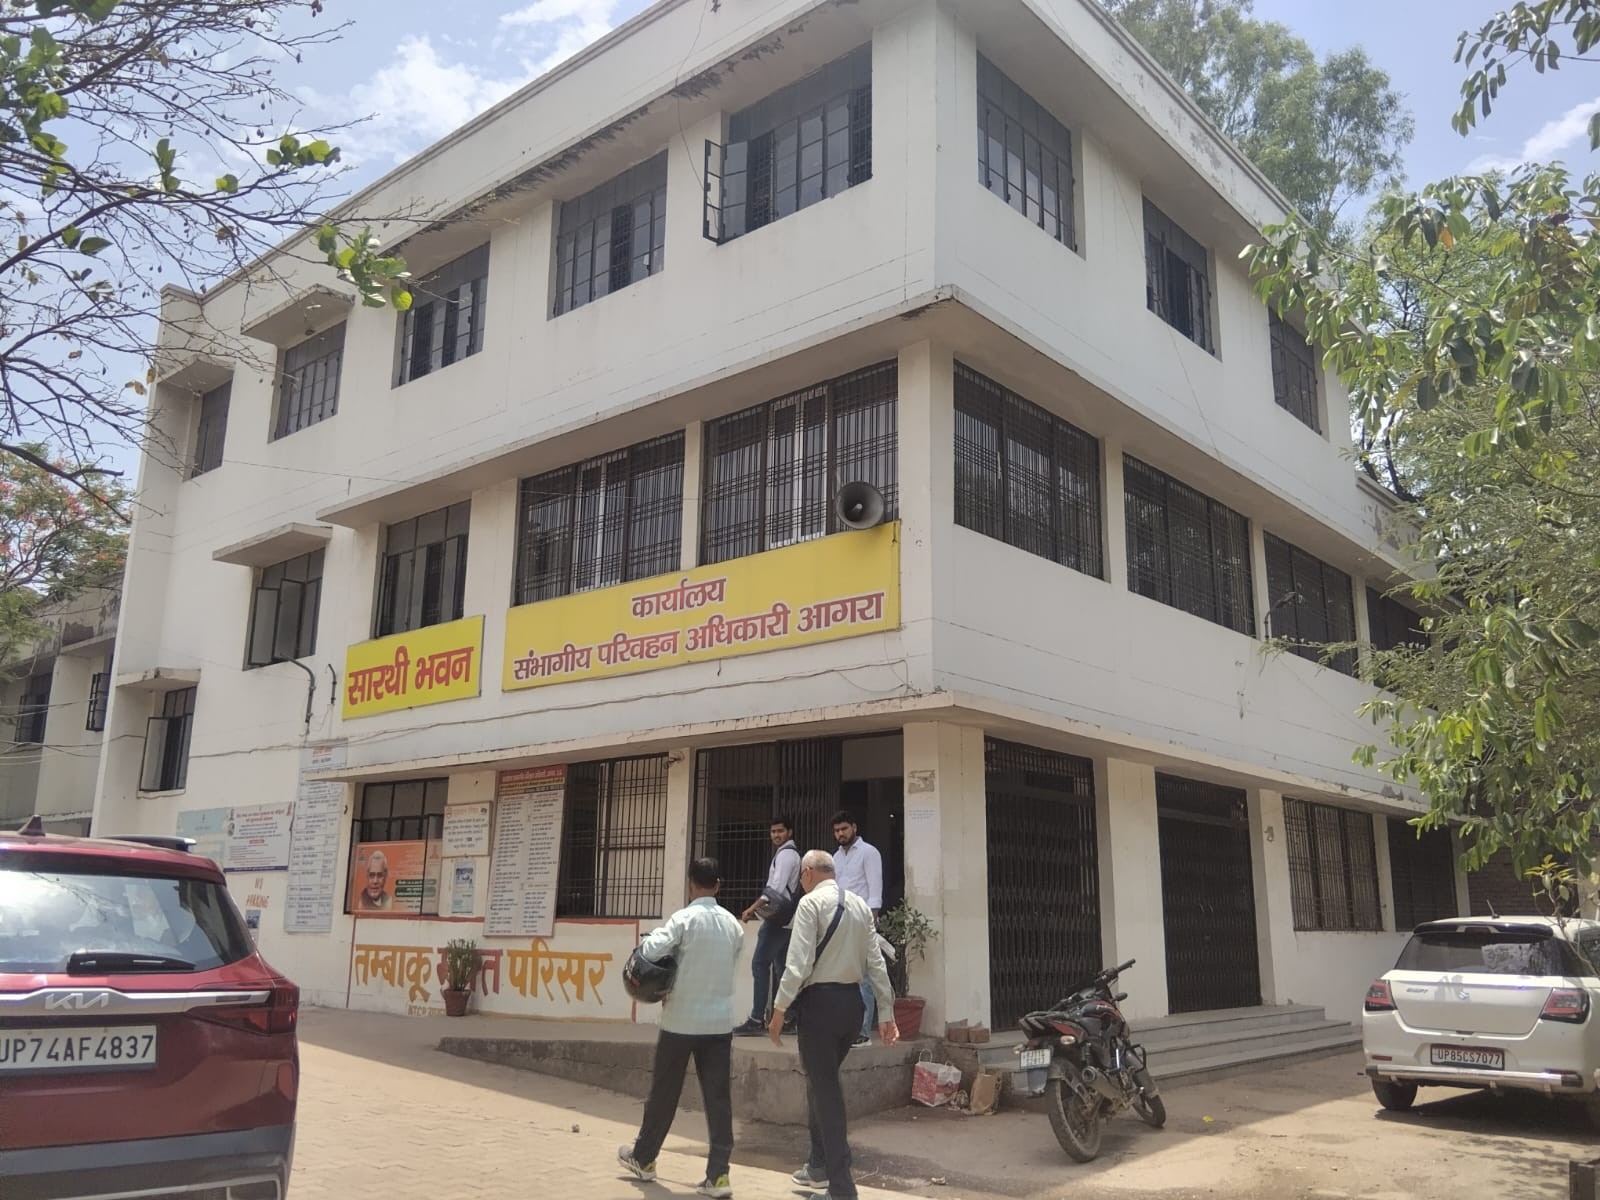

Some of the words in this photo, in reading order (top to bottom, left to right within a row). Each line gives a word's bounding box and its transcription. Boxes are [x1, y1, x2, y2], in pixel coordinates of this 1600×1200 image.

[632, 578, 727, 617] कार्यालय
[514, 643, 593, 680] संभागीय
[598, 633, 681, 665] परिवहन
[685, 603, 791, 651] अधिकारी
[797, 592, 885, 632] आगरा
[348, 645, 411, 705] सारथी
[415, 646, 475, 690] भवन
[354, 943, 434, 1002] तम्बाकू
[507, 937, 613, 1005] परिसर
[44, 992, 109, 1010] KIA
[0, 1035, 154, 1063] UP74AF4837
